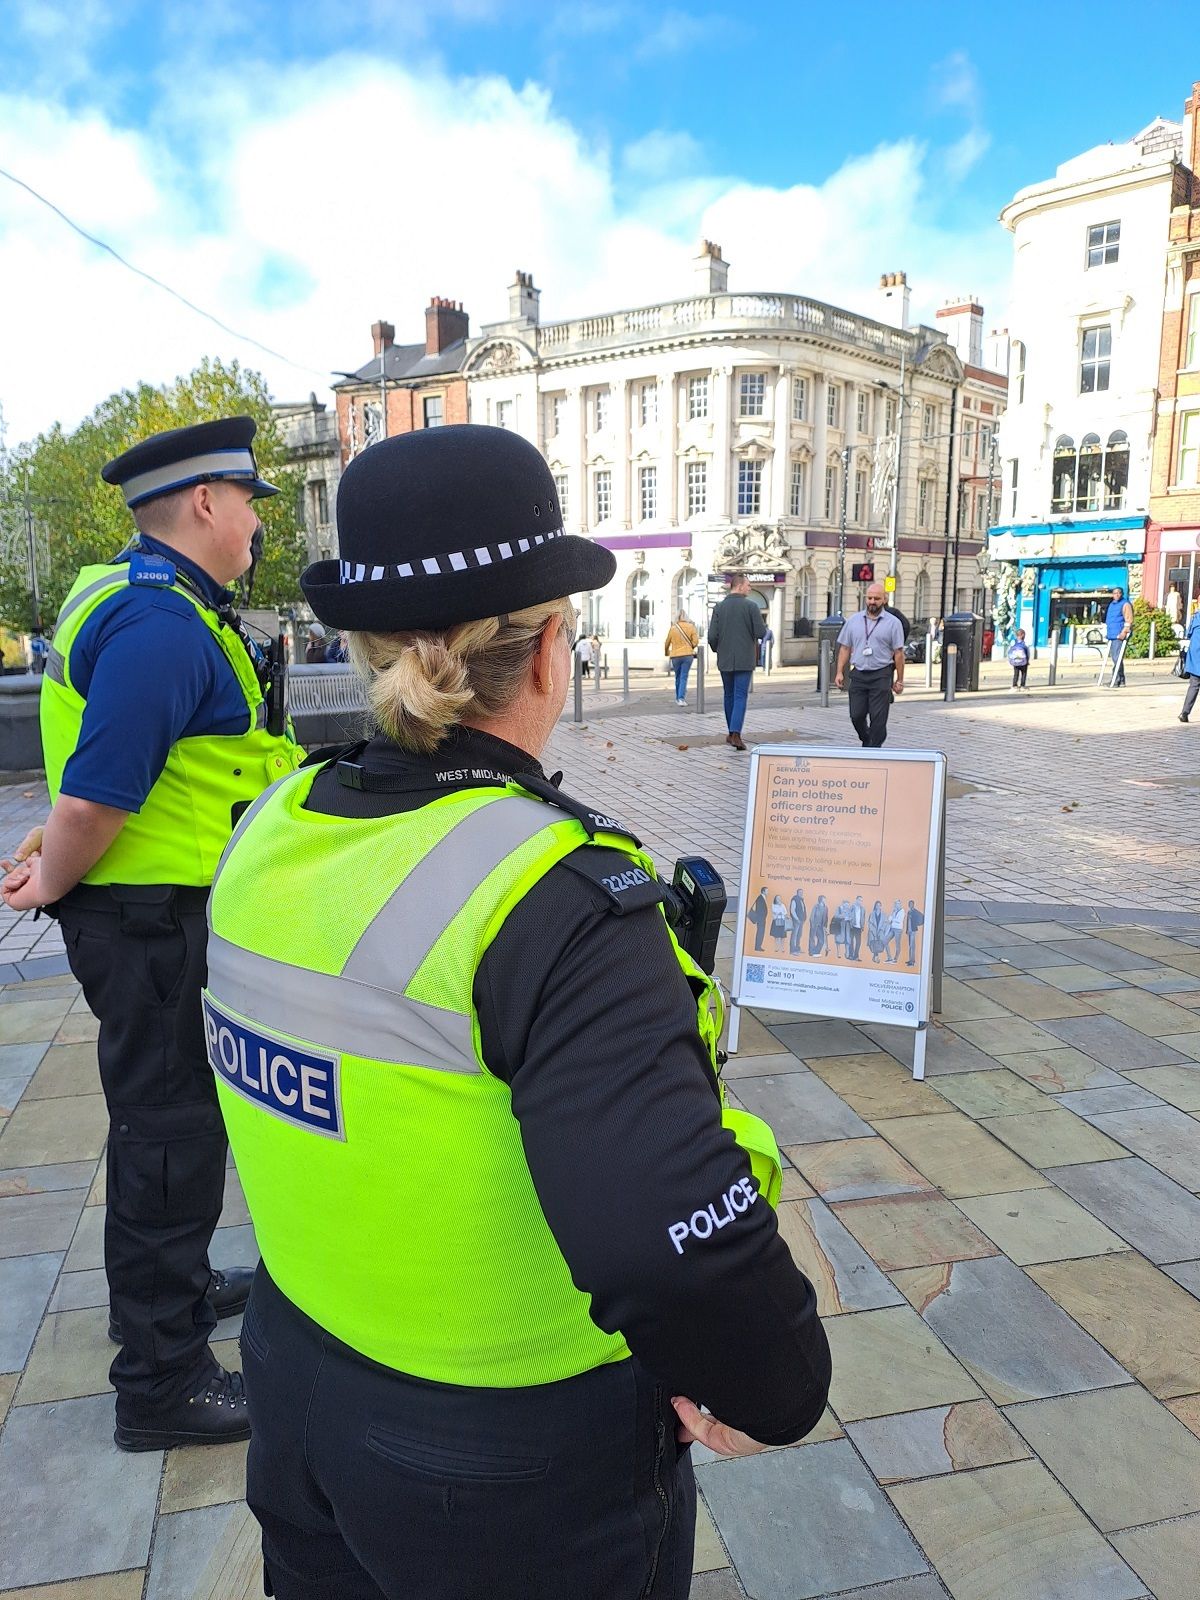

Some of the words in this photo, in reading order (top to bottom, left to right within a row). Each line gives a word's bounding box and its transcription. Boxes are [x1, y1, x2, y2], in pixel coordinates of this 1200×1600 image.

[435, 769, 468, 782] WEST
[773, 776, 794, 785] Can
[798, 778, 818, 788] you
[822, 779, 847, 789] spot
[850, 780, 870, 789] our
[772, 788, 798, 798] plain
[802, 790, 844, 800] clothes
[771, 801, 813, 812] officers
[816, 804, 856, 814] around
[860, 805, 878, 814] the
[770, 814, 790, 824] city
[793, 816, 836, 825] centre?
[602, 868, 650, 892] 22420
[206, 1012, 330, 1120] POLICE
[668, 1177, 758, 1254] POLICE
